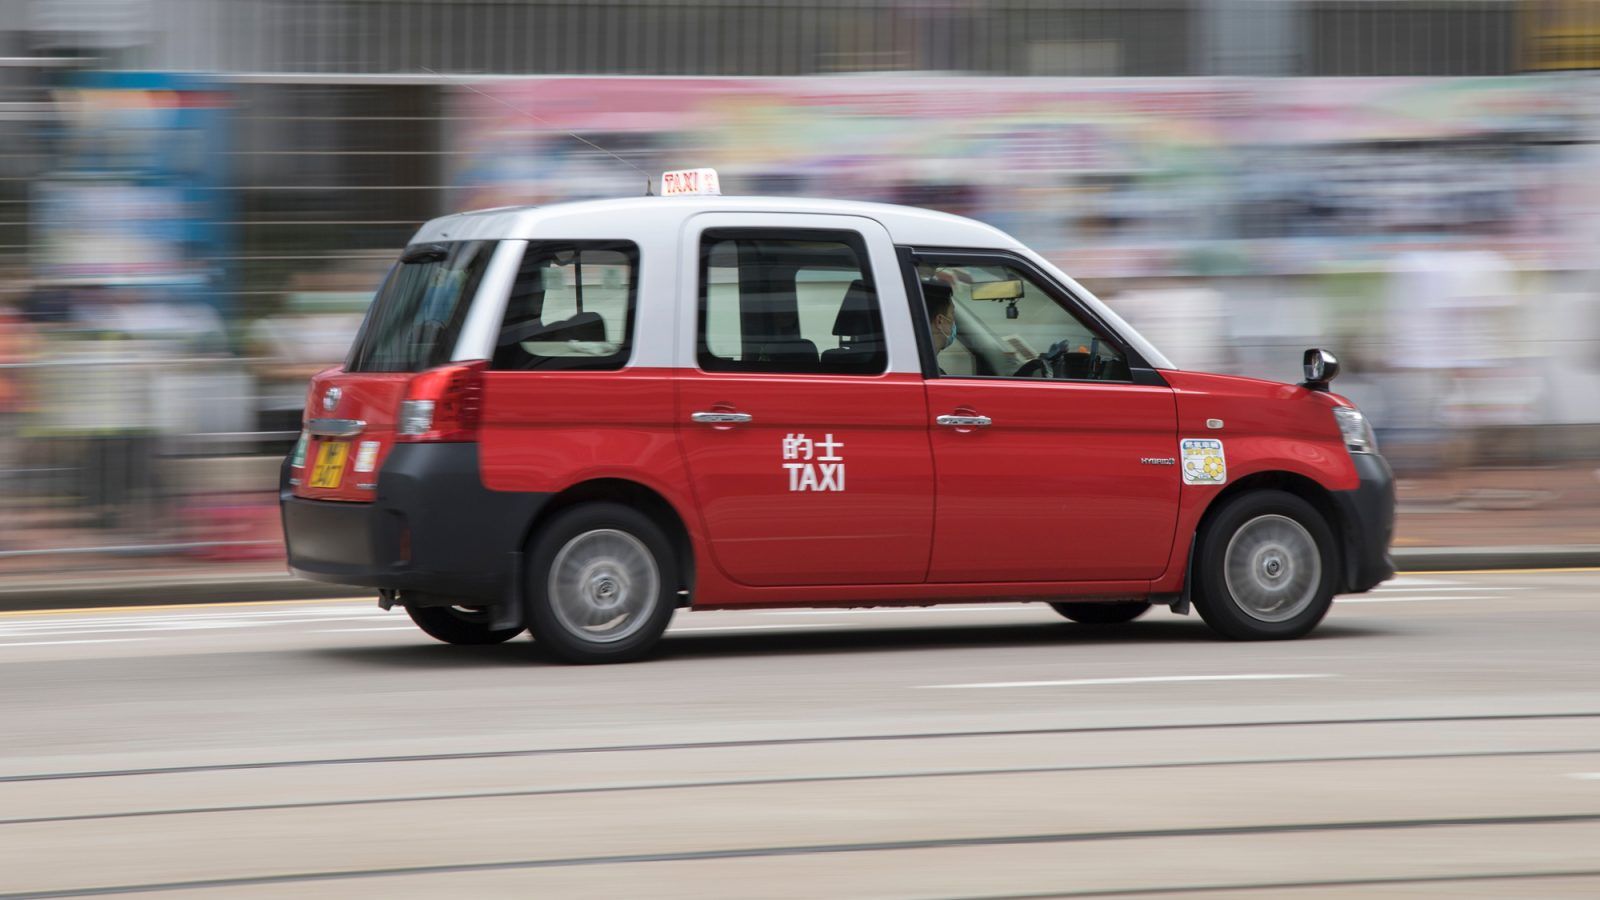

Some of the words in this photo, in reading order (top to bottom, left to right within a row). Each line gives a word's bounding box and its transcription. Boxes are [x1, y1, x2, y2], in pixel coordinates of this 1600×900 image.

[664, 172, 699, 193] TAXI
[782, 433, 845, 461] 的士
[782, 463, 846, 492] TAXI
